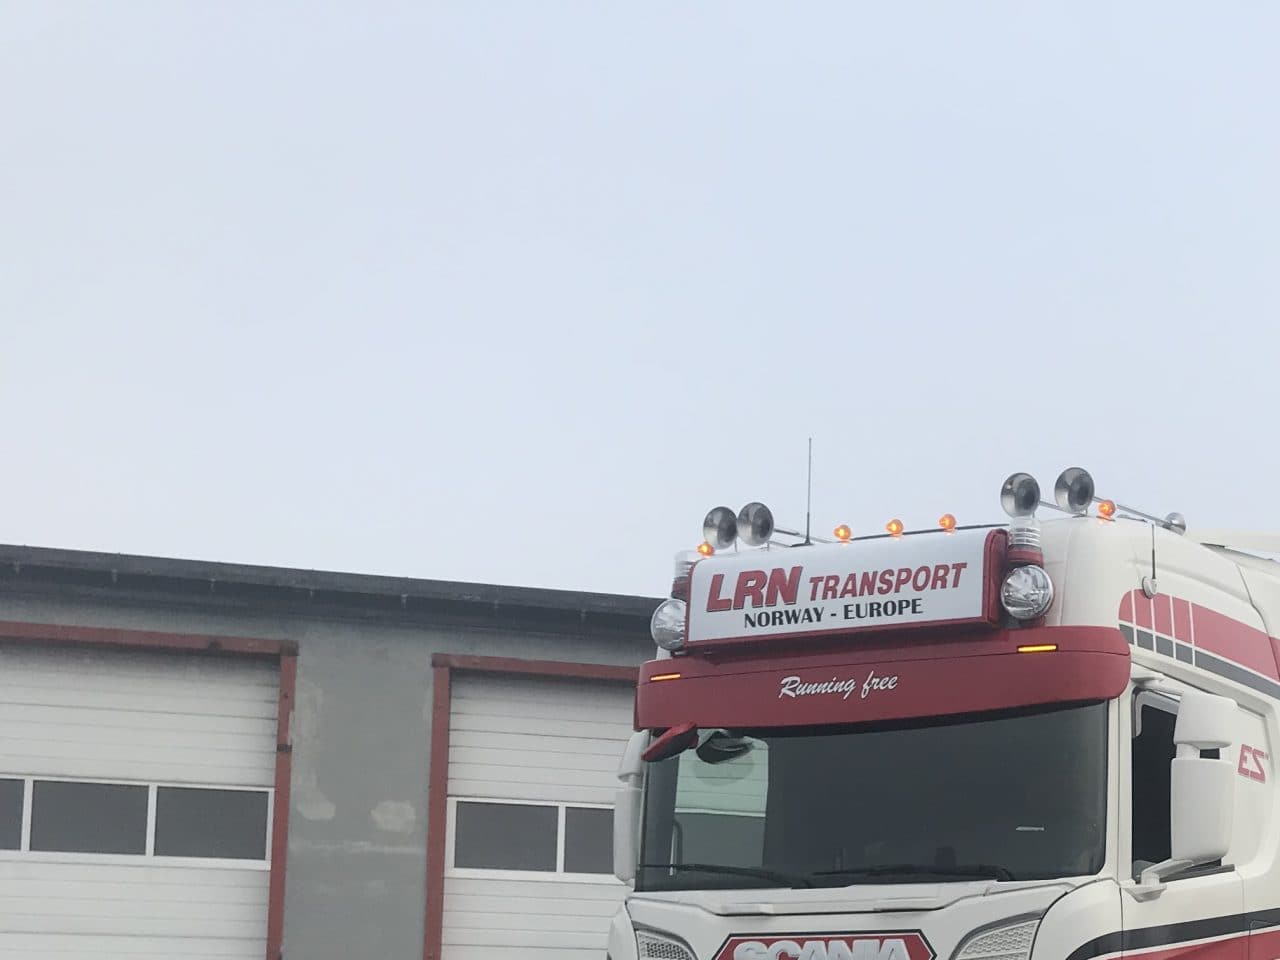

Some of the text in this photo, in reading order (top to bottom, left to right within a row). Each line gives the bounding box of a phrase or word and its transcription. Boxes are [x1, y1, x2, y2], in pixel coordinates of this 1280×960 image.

[706, 562, 968, 612] LRN TRANSPORT
[744, 606, 825, 628] NORWAY
[843, 598, 924, 620] EUROPE
[778, 670, 899, 700] Running free
